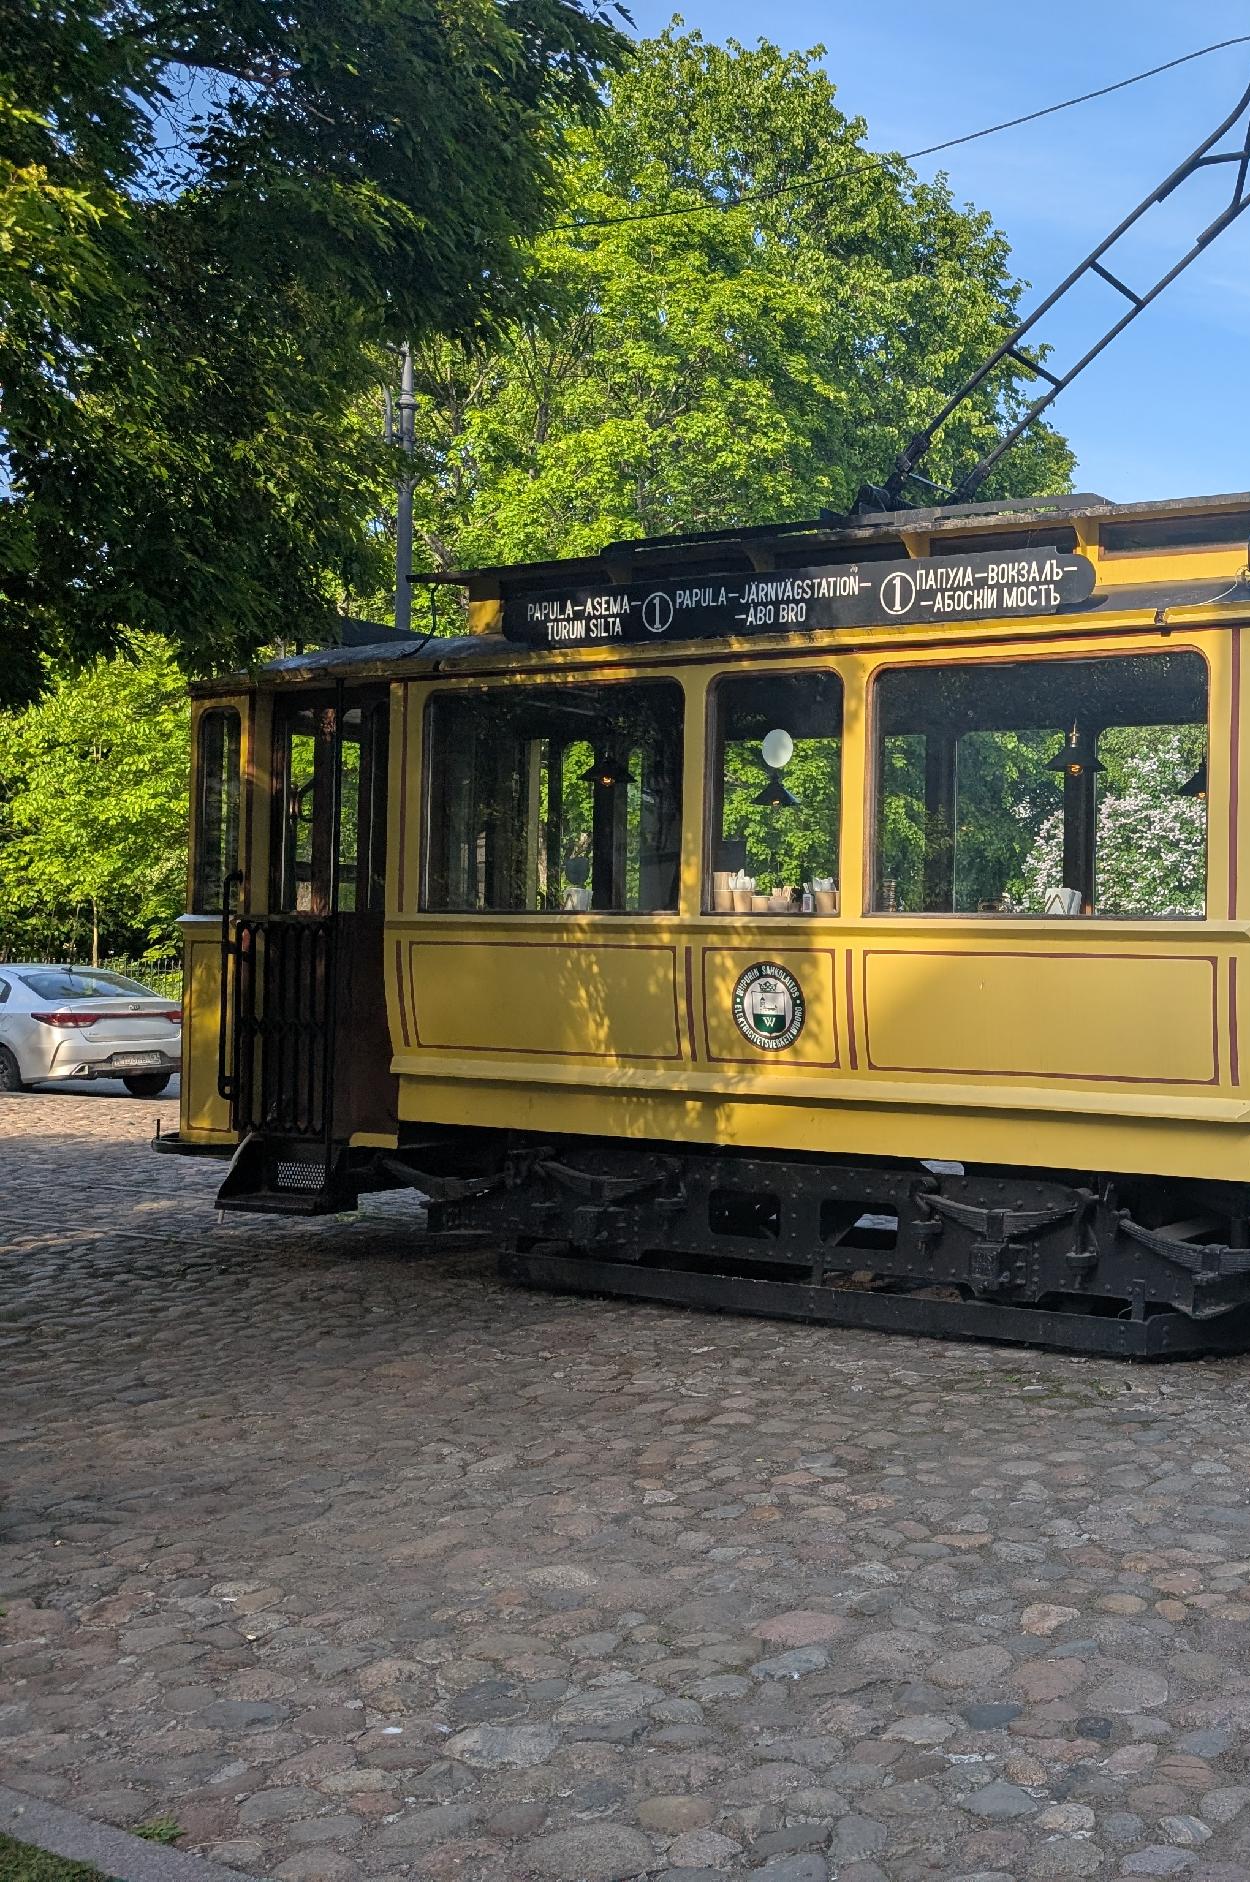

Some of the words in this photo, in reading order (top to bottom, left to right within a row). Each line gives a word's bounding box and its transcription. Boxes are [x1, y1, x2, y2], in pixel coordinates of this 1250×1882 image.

[1003, 584, 1061, 608] МОСТЪ
[779, 602, 807, 623] BRO
[546, 619, 586, 641] TURUN
[589, 617, 623, 638] SILTA
[762, 1016, 776, 1028] W
